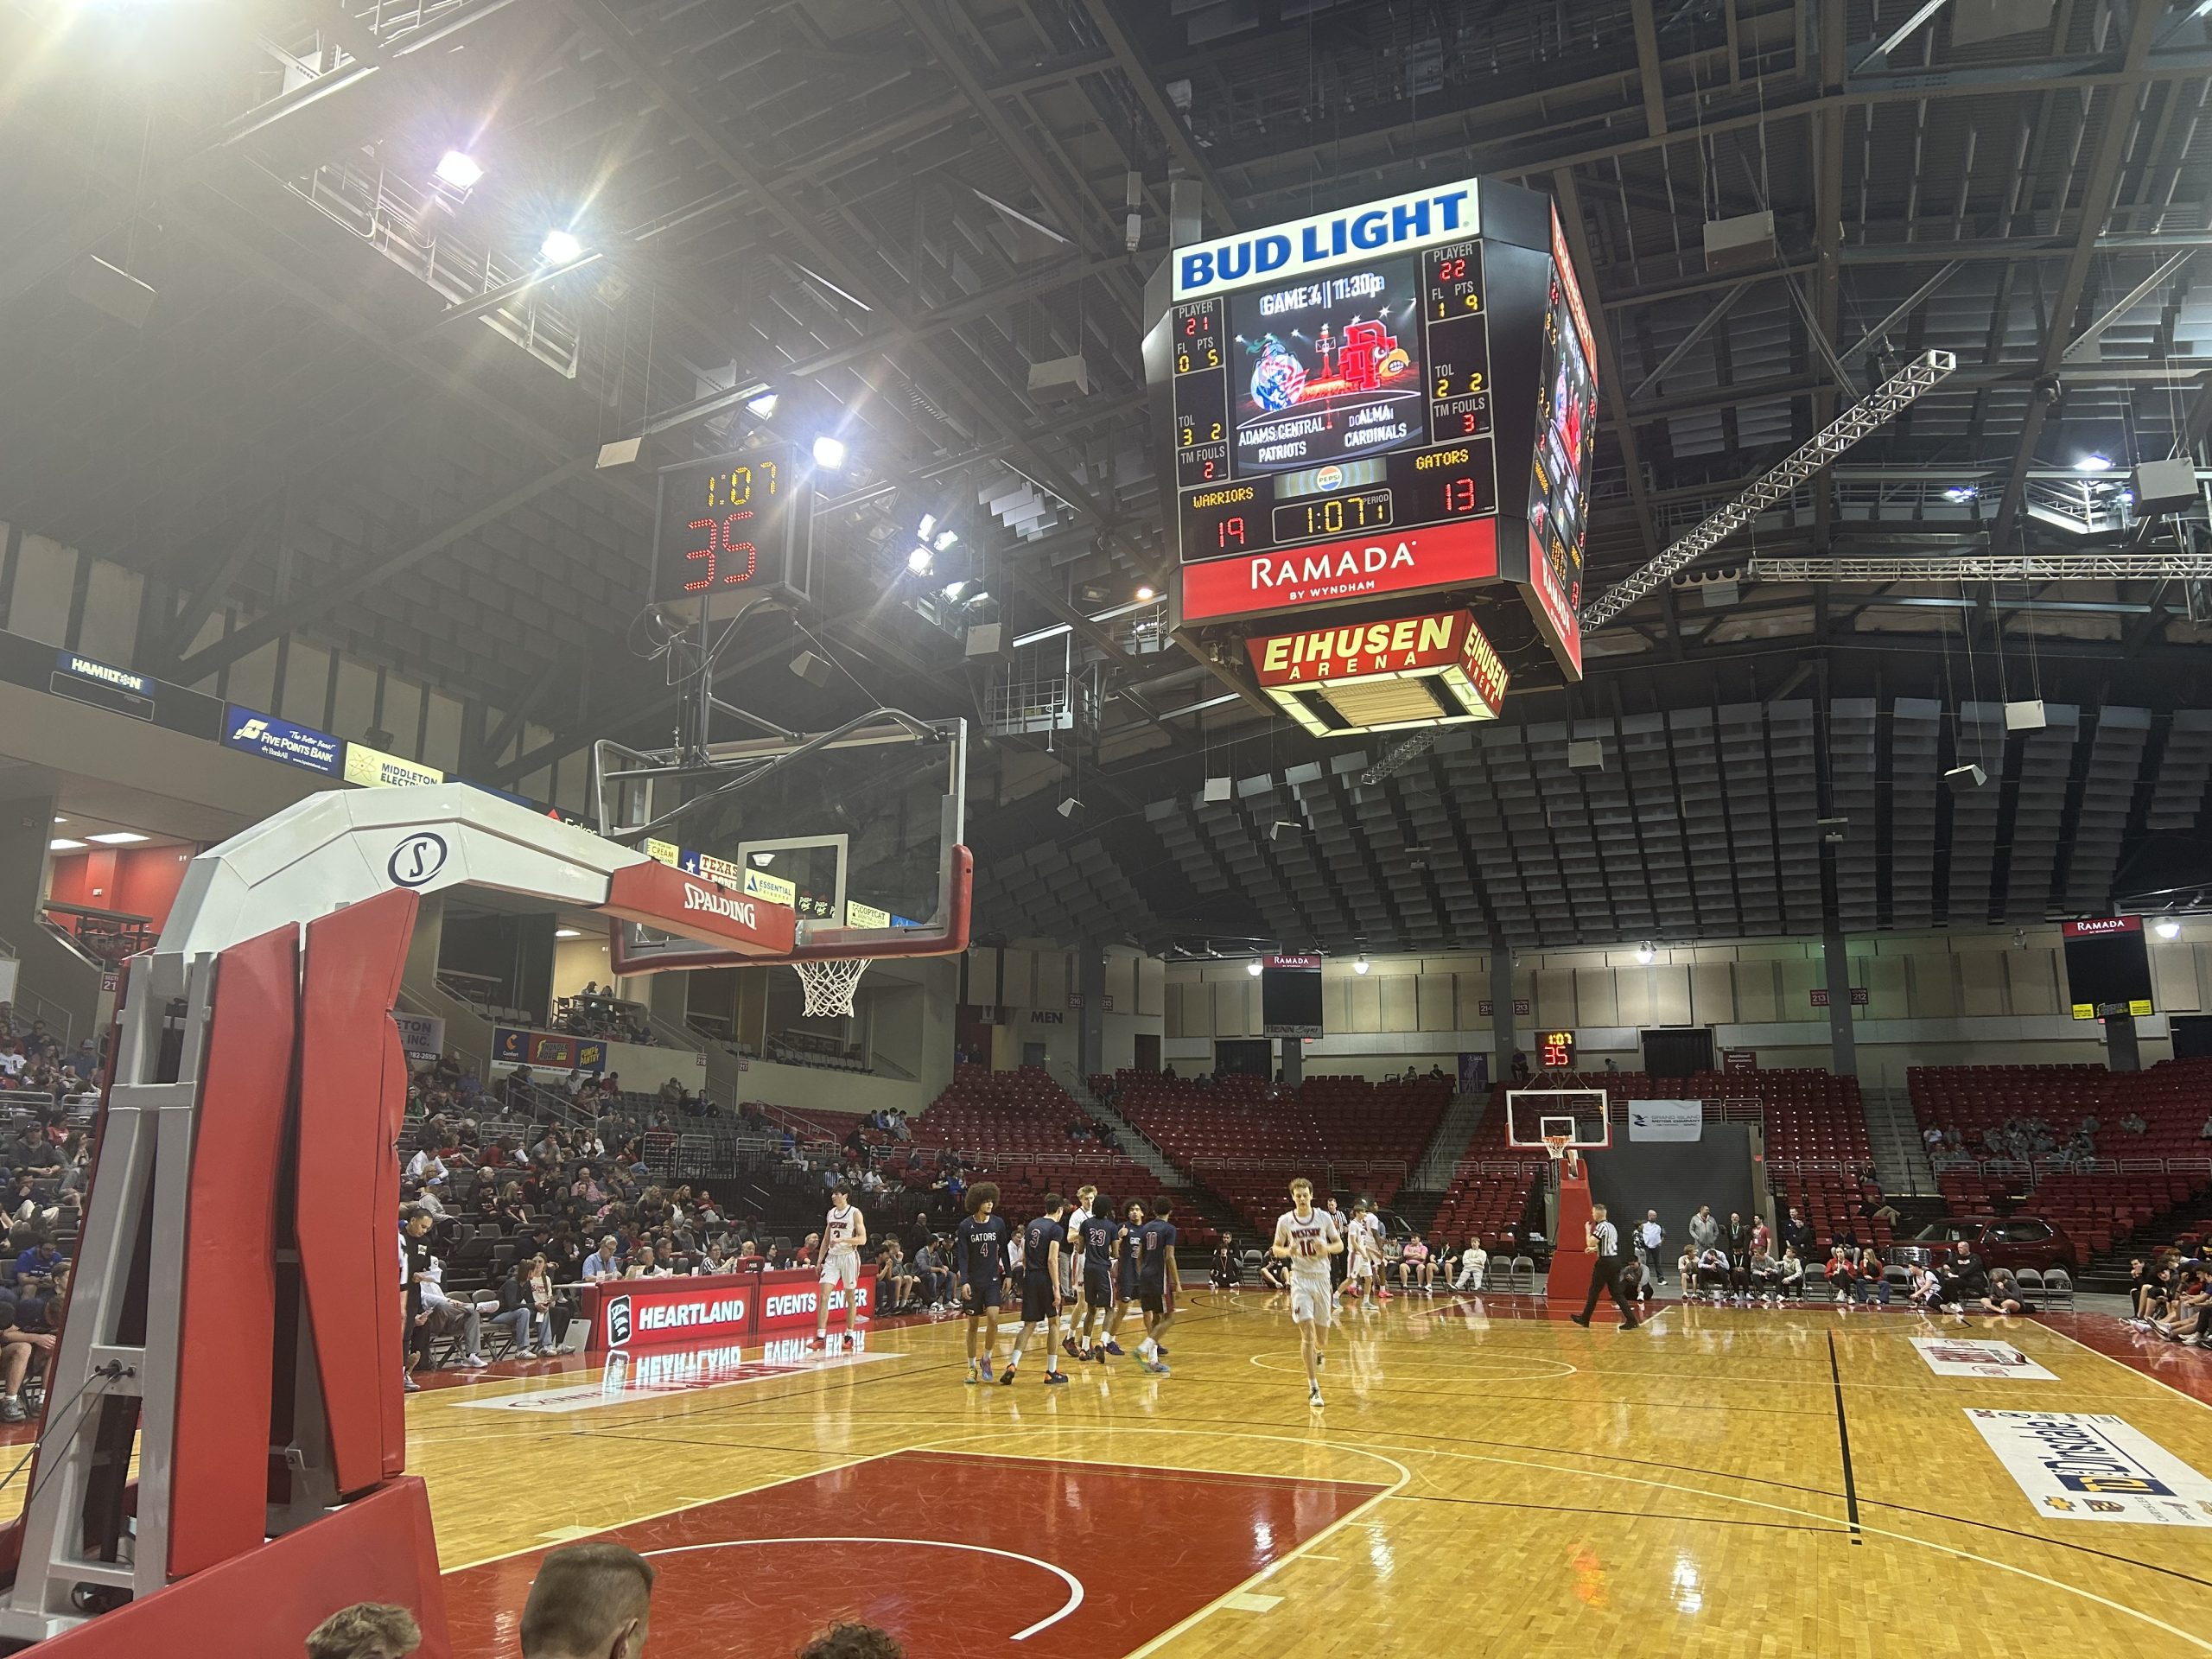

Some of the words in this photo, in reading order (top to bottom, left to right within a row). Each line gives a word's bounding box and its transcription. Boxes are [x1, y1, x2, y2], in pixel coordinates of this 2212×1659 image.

[1181, 235, 1292, 290] BUD
[1301, 190, 1468, 263] LIGHT
[1433, 244, 1472, 262] PLAYER
[1441, 259, 1465, 280] 22
[1432, 288, 1444, 300] FL
[1454, 281, 1474, 296] PTS
[1179, 302, 1213, 319] PLAYER
[1439, 302, 1445, 318] 1
[1465, 295, 1478, 310] 9
[1186, 316, 1209, 335] 21
[1178, 343, 1187, 354] FL
[1197, 337, 1214, 351] PTS
[1179, 355, 1190, 372] 0
[1208, 349, 1218, 366] 5
[1435, 364, 1454, 378] TOL
[1437, 378, 1449, 397] 2
[1470, 372, 1483, 391] 2
[1434, 404, 1449, 417] TM
[1452, 397, 1484, 415] FOULS
[1179, 416, 1195, 428] TOL
[1238, 428, 1276, 446] ADAMS
[1277, 416, 1325, 438] CENTRAL
[1463, 413, 1475, 432] 3
[1183, 428, 1192, 446] 3
[1211, 423, 1221, 441] 2
[1344, 423, 1408, 448] CARDINALS
[1181, 453, 1194, 465] TM
[1197, 446, 1225, 461] FOULS
[1258, 442, 1306, 463] PATRIOTS
[1414, 449, 1470, 470] GATORS
[1204, 461, 1214, 480] 2
[1319, 474, 1340, 484] PEPSI
[709, 461, 777, 507] 1:07
[1192, 487, 1254, 509] WARRIORS
[1363, 493, 1389, 505] PERIOD
[1445, 478, 1476, 512] 13
[1306, 497, 1364, 534] 1:07
[1218, 517, 1245, 548] 19
[684, 511, 757, 591] 35
[1251, 542, 1414, 589] RAMADA
[1289, 590, 1305, 601] BY
[1310, 580, 1375, 598] WYNDHAM
[1542, 556, 1571, 636] RAMADA
[1262, 614, 1454, 672] EIHUSEN
[1288, 651, 1417, 681] ARENA
[1463, 622, 1510, 702] EIHUSEN
[71, 658, 143, 690] HAMILTON
[1466, 660, 1496, 704] ARENA
[260, 731, 281, 747] FIVE
[280, 737, 310, 756] POINTS
[309, 747, 334, 763] BANK
[381, 762, 438, 785] MIDDLETON
[652, 846, 674, 860] CREAM
[702, 856, 738, 878] TEXAS
[760, 880, 791, 895] ESSENTIAL
[684, 882, 757, 931] SPALDING
[860, 906, 886, 920] COPYCAT
[2077, 919, 2125, 931] RAMADA
[104, 981, 117, 991] 21
[1030, 1011, 1064, 1024] MEN
[407, 1034, 429, 1046] INC.
[1548, 1033, 1573, 1046] 1:07
[1544, 1046, 1569, 1065] 35
[970, 1232, 996, 1243] GATORS
[1029, 1229, 1041, 1249] 3
[1089, 1228, 1106, 1247] 23
[980, 1243, 988, 1257] 4
[766, 1293, 817, 1318] EVENTS
[827, 1287, 868, 1311] ENER
[638, 1300, 745, 1331] HEARTLAND
[2011, 1421, 2132, 1472] Dinsdale
